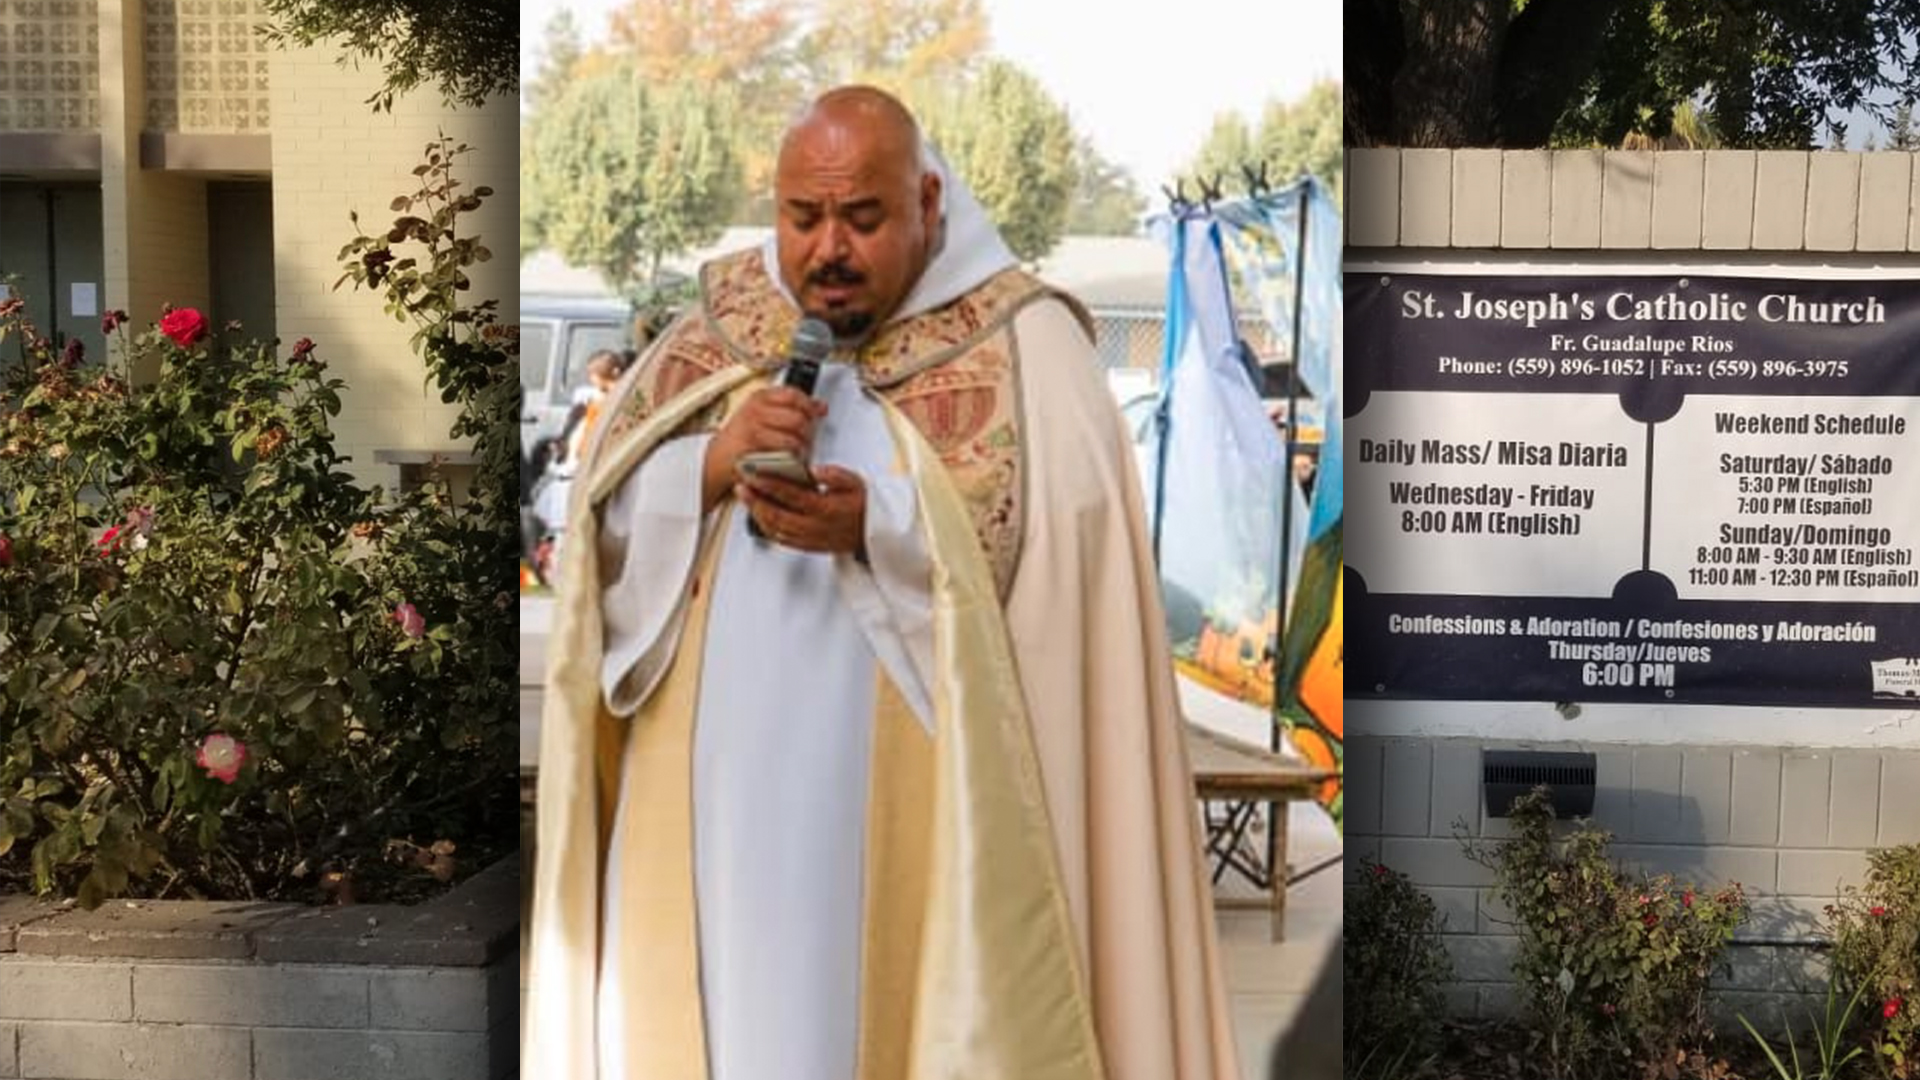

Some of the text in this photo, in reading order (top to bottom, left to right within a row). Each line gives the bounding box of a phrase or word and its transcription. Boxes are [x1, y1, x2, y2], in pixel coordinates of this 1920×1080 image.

[1402, 290, 1885, 327] St. Joseph's Catholic Church
[1551, 335, 1733, 356] Fr. Guadalupe Rios
[1439, 357, 1502, 374] Phone:
[1508, 358, 1555, 377] (559)
[1561, 359, 1644, 376] 896-1052
[1661, 359, 1702, 376] Fax:
[1708, 360, 1756, 380] (559)
[1762, 361, 1848, 378] 896-3975
[1715, 413, 1905, 435] Weekend Schedule
[1359, 439, 1627, 467] Daily Mass/ Misa Diaria
[1720, 453, 1892, 476] Saturday/ Sábado
[1389, 481, 1513, 508] Wednesday
[1530, 485, 1594, 509] Friday
[1739, 477, 1773, 493] 5:30
[1778, 477, 1799, 493] PM
[1737, 498, 1769, 514] 7:00
[1774, 498, 1795, 514] PM
[1402, 510, 1446, 532] 8:00
[1451, 512, 1482, 533] AM
[1720, 524, 1891, 548] Sunday/Domingo
[1697, 547, 1732, 564] 8:00
[1736, 547, 1760, 564] AM
[1774, 548, 1809, 565] 9:30
[1813, 548, 1837, 565] AM
[1689, 568, 1728, 585] 11:00
[1732, 569, 1756, 585] AM
[1769, 568, 1812, 586] 12:30
[1815, 569, 1839, 587] PM
[1389, 615, 1506, 635] Confessions
[1510, 619, 1523, 635] &
[1527, 617, 1620, 637] Adoration
[1638, 619, 1758, 640] Confesiones
[1762, 625, 1773, 643] y
[1777, 620, 1876, 642] Adoración
[1548, 641, 1711, 663] Thursday/Jueves
[1582, 662, 1674, 686] 6:00 PM
